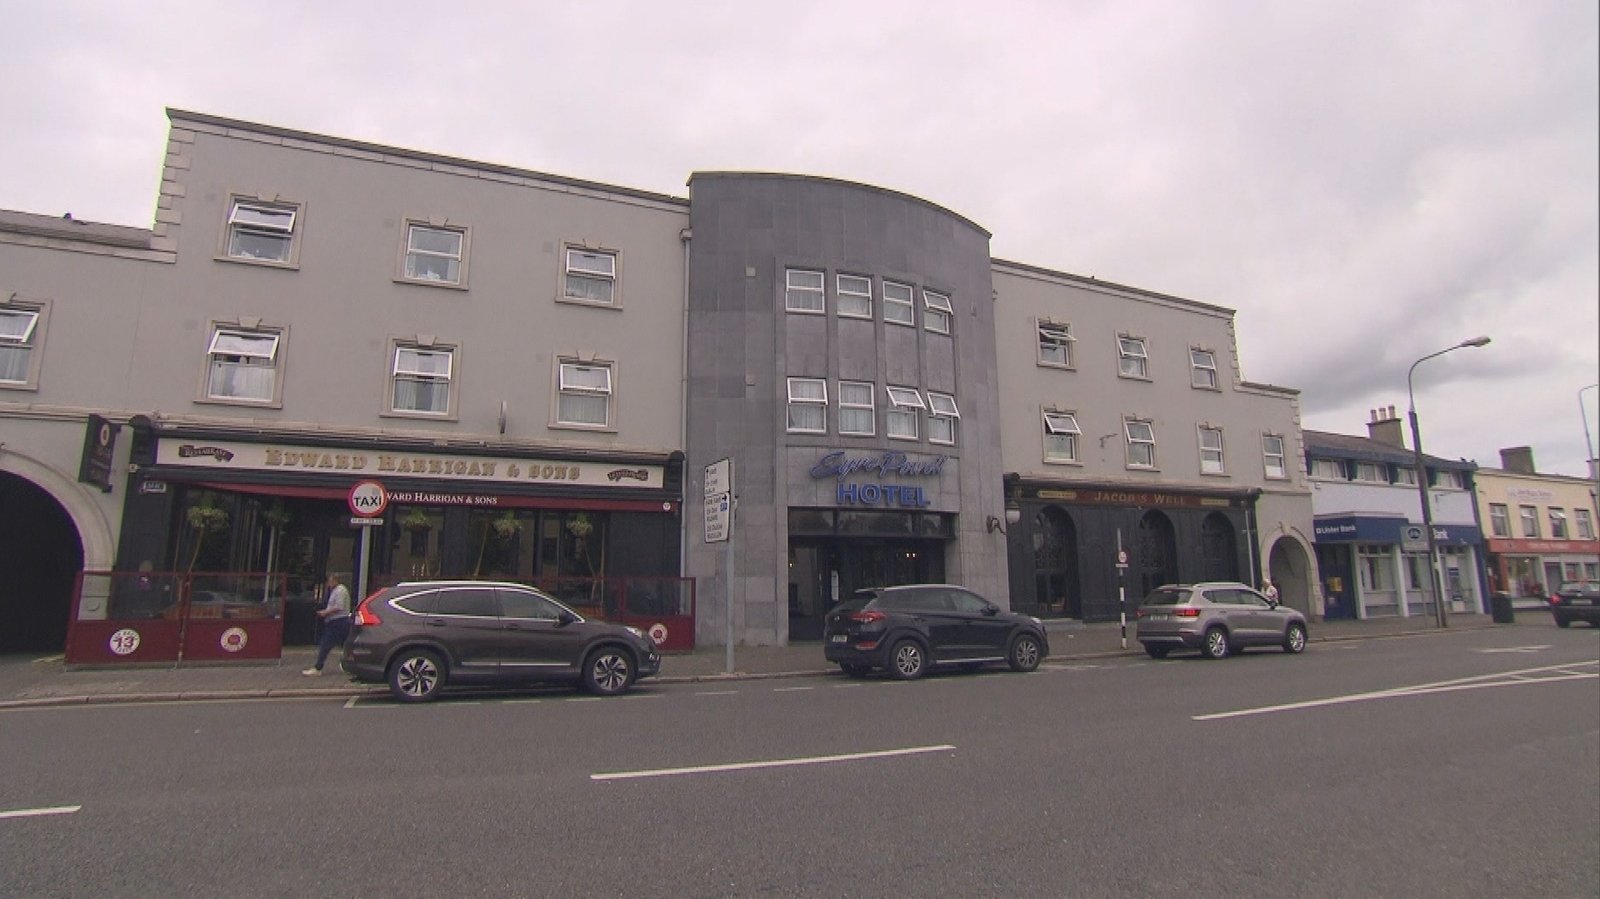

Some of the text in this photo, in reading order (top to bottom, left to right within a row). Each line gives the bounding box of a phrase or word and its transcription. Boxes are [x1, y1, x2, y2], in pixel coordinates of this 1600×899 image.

[265, 449, 581, 481] EDWARD HARRIGAN & SONS
[354, 495, 382, 507] TAXI
[415, 492, 463, 504] HARRIGAN
[474, 496, 498, 505] SONS
[837, 482, 931, 507] HOTEL
